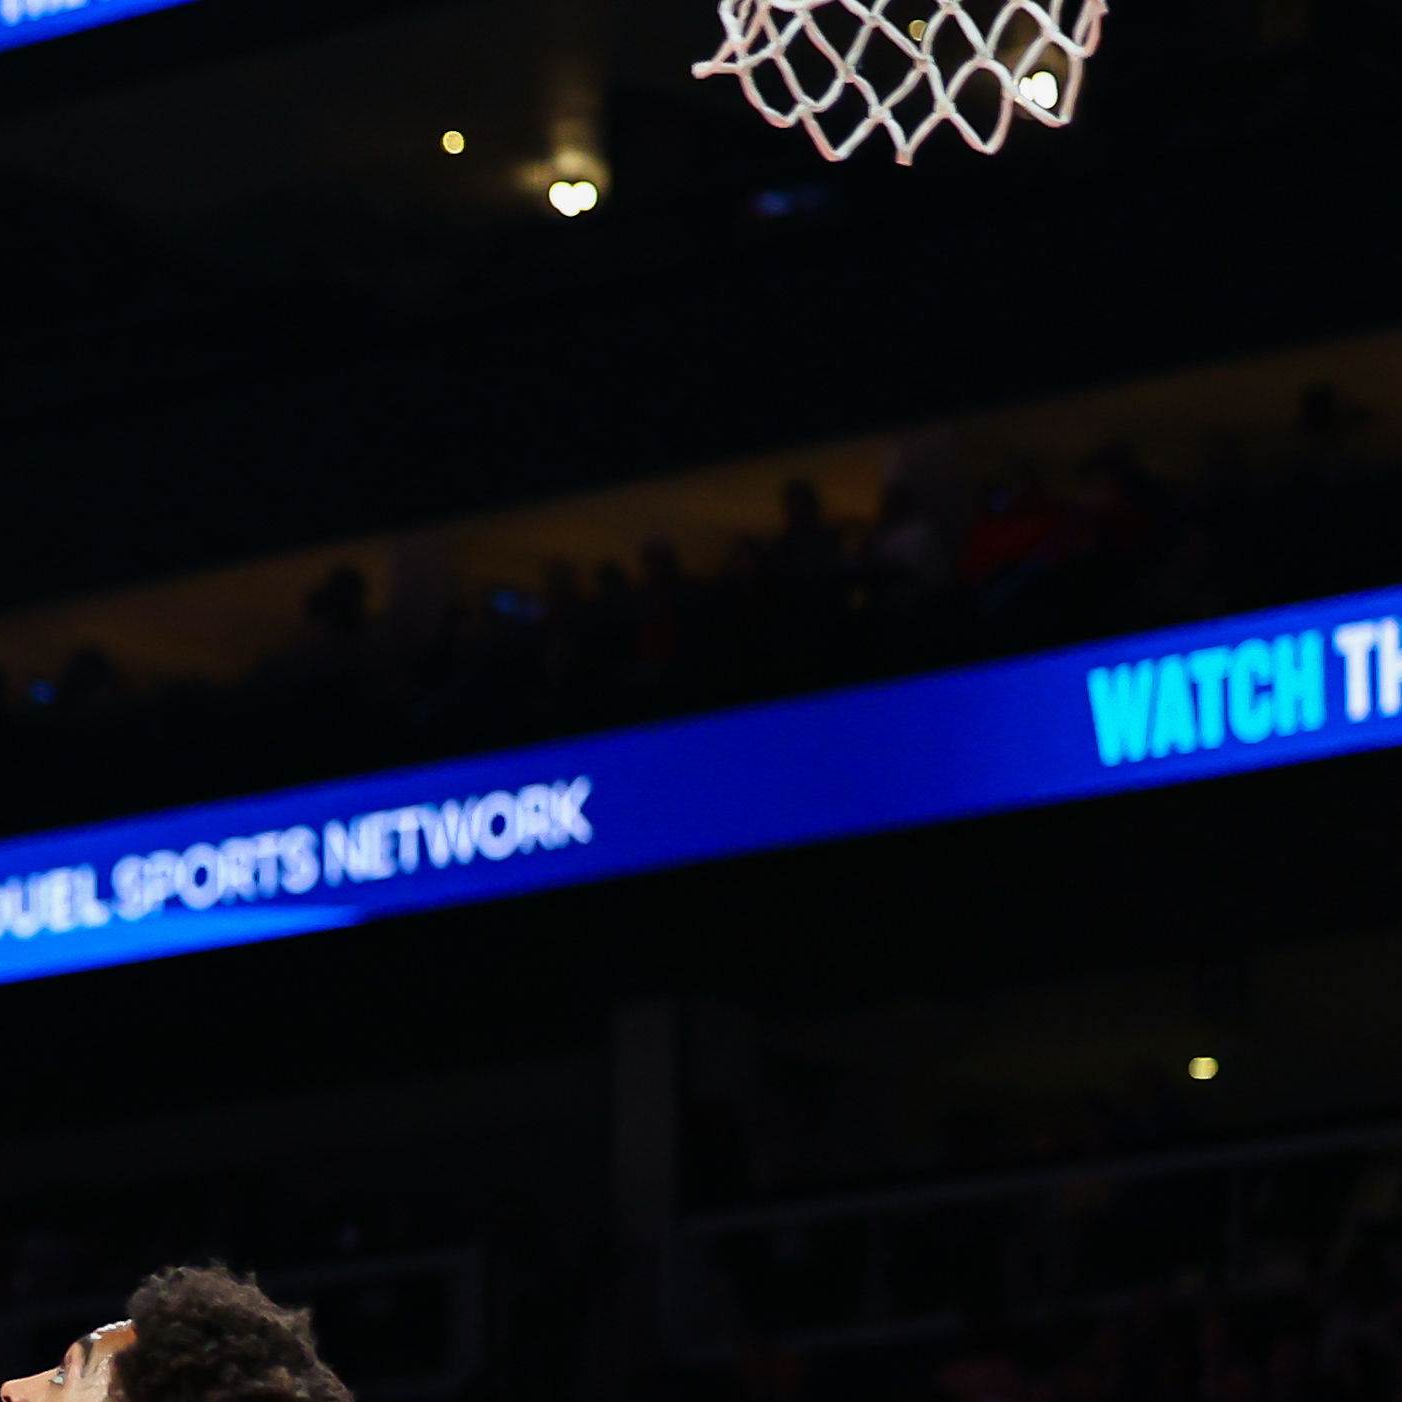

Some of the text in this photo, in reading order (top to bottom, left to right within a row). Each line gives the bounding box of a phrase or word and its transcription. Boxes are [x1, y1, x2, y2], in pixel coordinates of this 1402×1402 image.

[1087, 629, 1327, 767] WATCH
[109, 827, 319, 922] SPORTS
[322, 775, 593, 887] NETWORK
